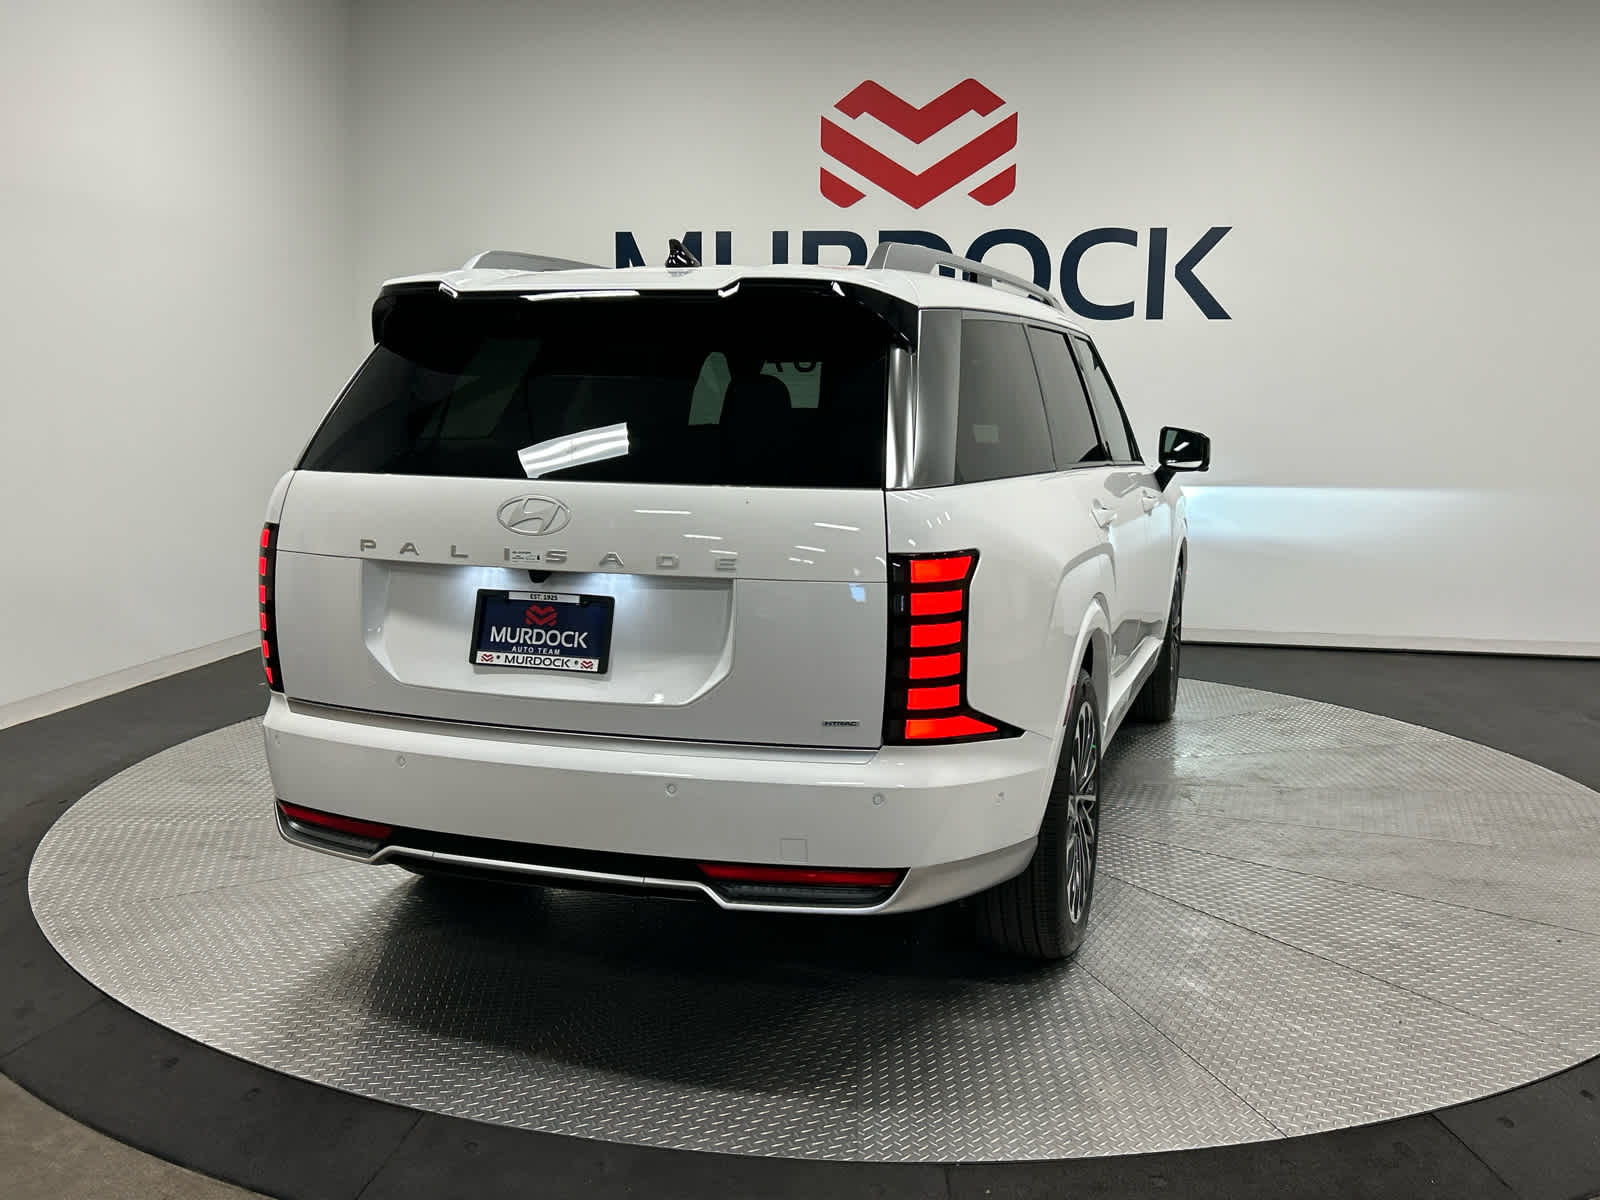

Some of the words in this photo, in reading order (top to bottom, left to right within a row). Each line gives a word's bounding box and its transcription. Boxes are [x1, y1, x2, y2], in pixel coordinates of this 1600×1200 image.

[360, 538, 738, 571] PALISADE
[530, 593, 543, 601] EST.
[490, 626, 588, 648] MURDOCK
[511, 646, 535, 654] AUTO
[538, 647, 561, 655] TEAM
[504, 654, 571, 667] MURDOCK
